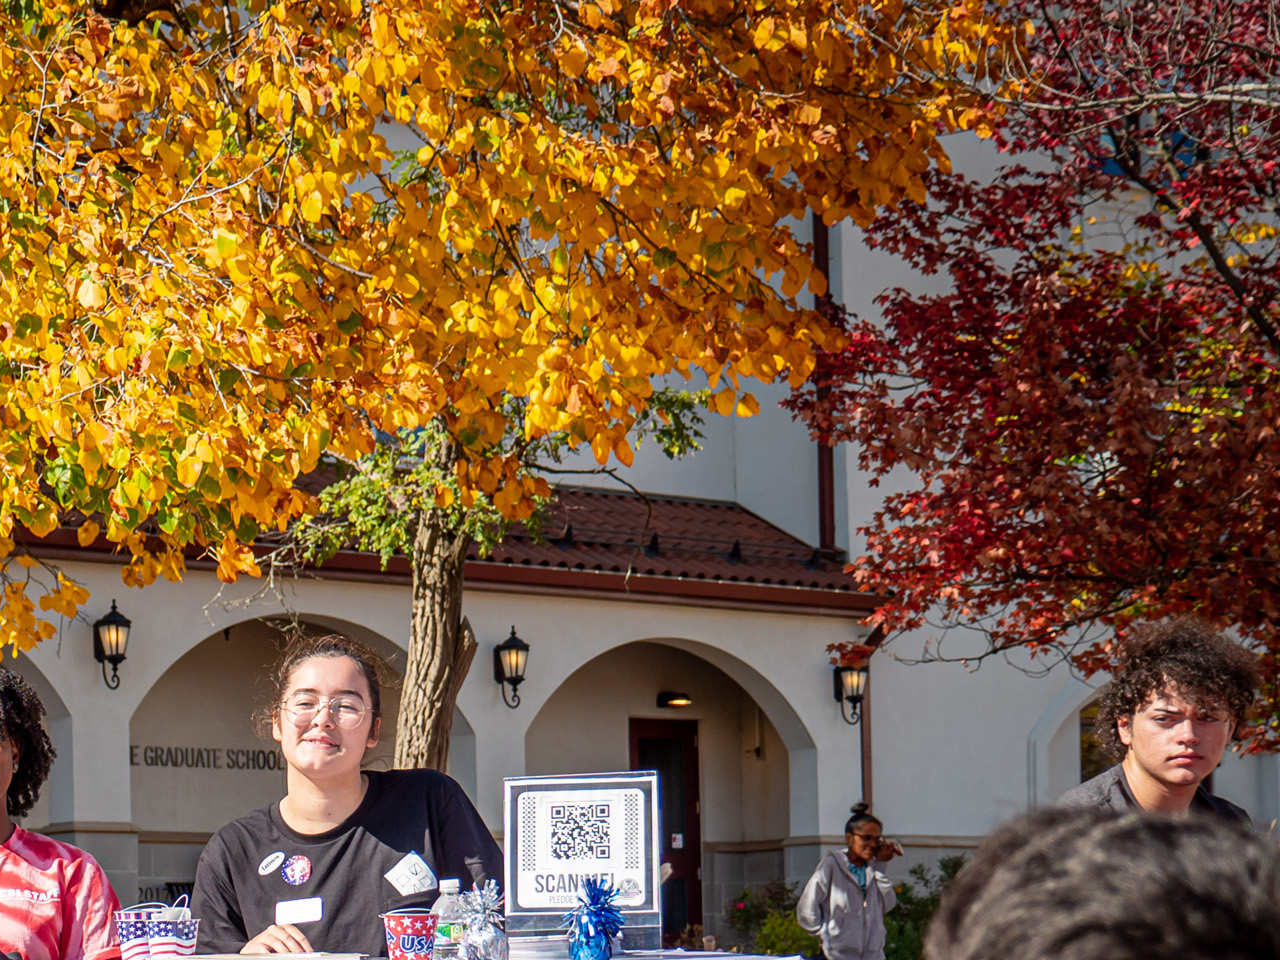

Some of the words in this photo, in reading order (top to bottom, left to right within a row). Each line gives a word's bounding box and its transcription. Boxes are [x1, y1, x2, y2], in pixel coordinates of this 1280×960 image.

[143, 745, 223, 769] GRADUATE
[226, 749, 286, 771] SCHOOL
[534, 873, 579, 893] SCAN
[23, 888, 60, 901] STAFF
[548, 895, 573, 904] PLEDGE
[400, 934, 434, 954] USA
